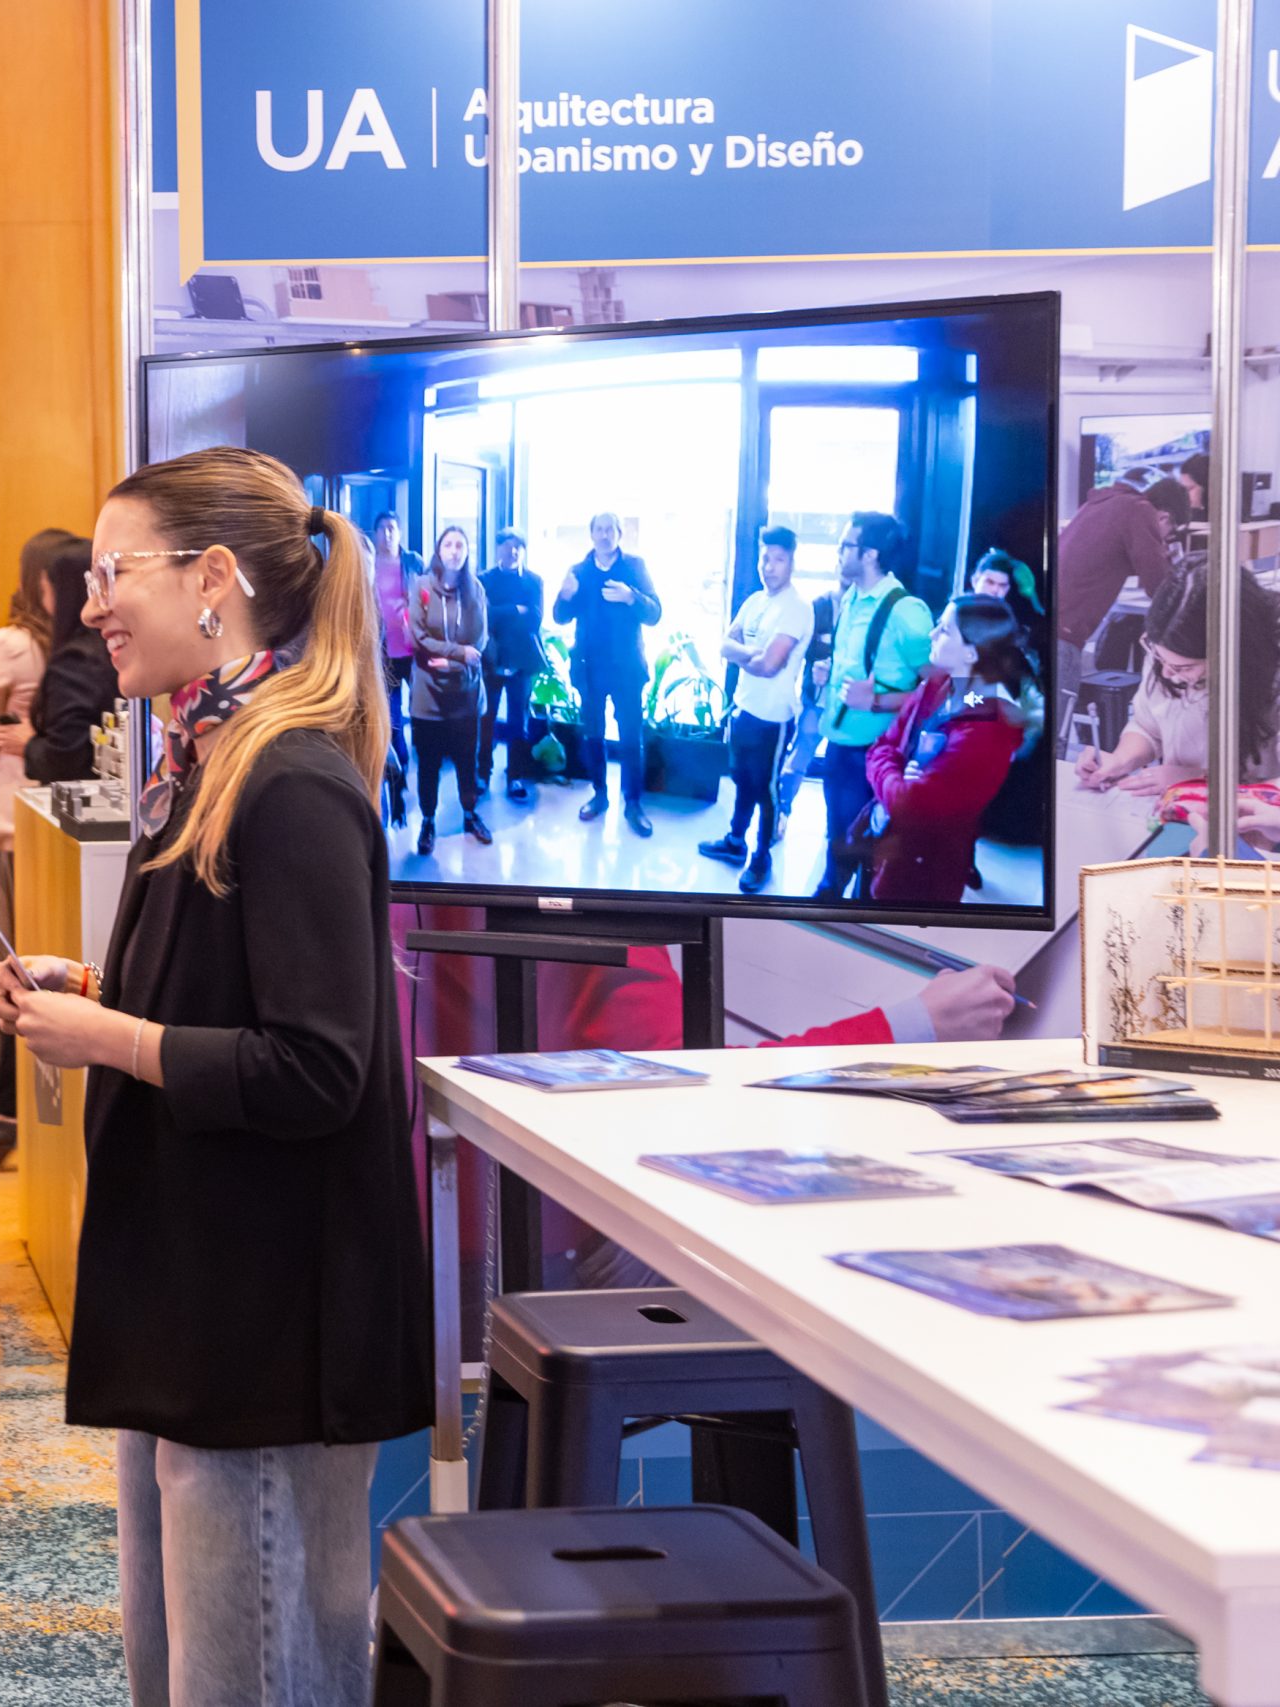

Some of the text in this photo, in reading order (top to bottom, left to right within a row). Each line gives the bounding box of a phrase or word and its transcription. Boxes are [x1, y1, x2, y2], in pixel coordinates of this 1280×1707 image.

[255, 88, 407, 172] UA
[463, 87, 715, 136] Aquitectura
[689, 143, 714, 177] y
[726, 131, 864, 170] Diseño
